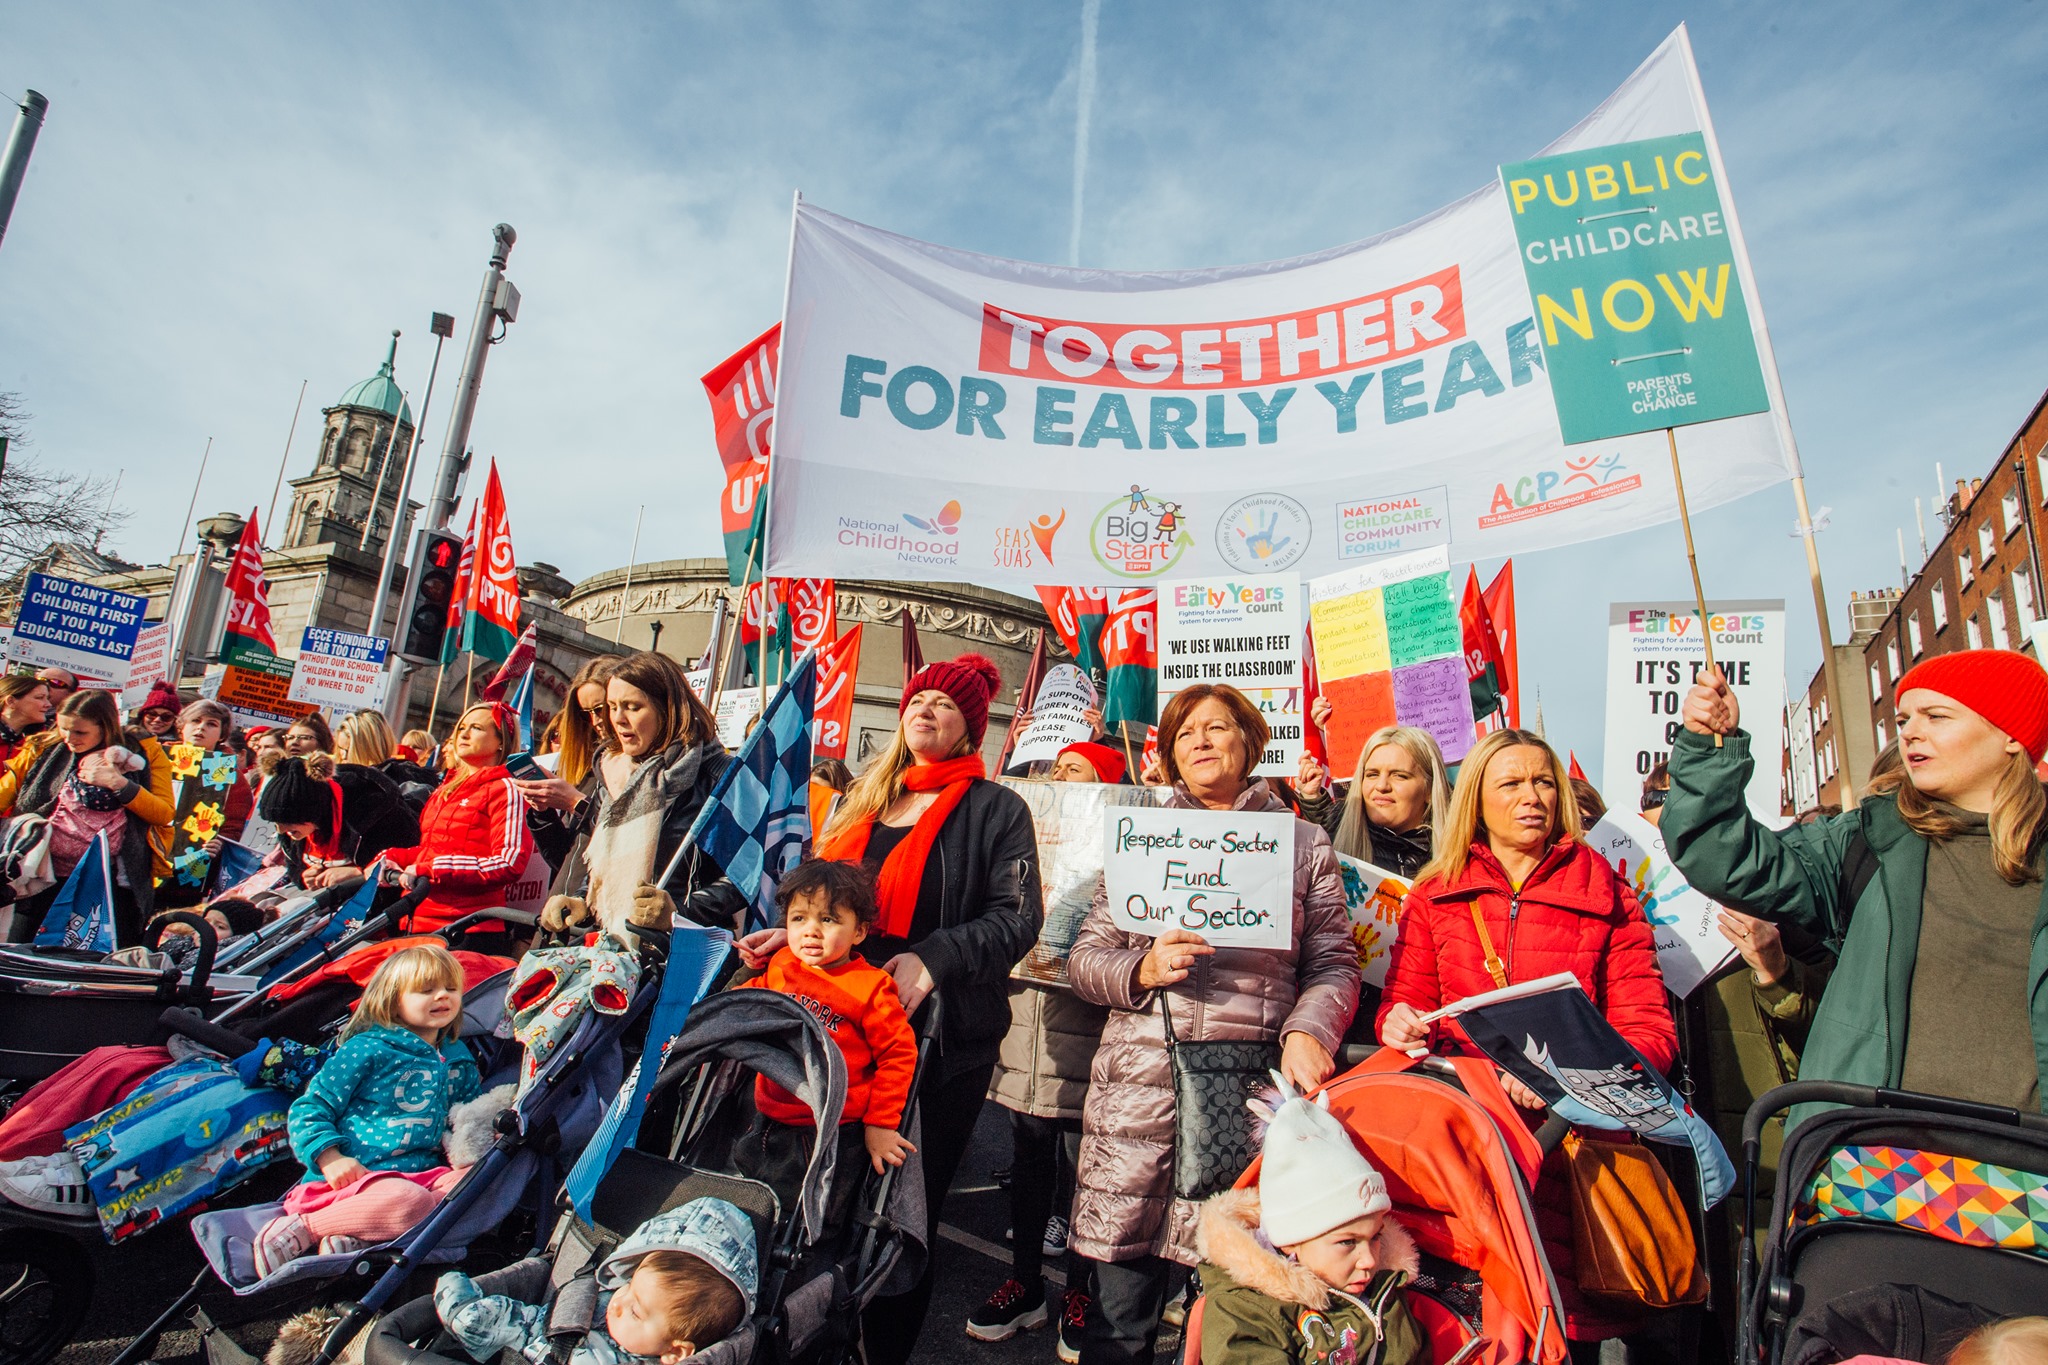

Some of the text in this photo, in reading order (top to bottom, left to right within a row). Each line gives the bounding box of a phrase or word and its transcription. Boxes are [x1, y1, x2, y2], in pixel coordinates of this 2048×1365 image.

[1509, 150, 1708, 215] PUBLIC
[1526, 211, 1723, 264] CHILDCARE
[1537, 263, 1730, 346] NOW
[999, 284, 1449, 385] TOGETHER
[840, 316, 1546, 450] FOR EARLY YEAR
[1626, 372, 1692, 394] PARENTS
[1644, 384, 1679, 402] FOR
[1631, 392, 1697, 414] CHANGE
[1490, 471, 1559, 514] ACP
[1497, 508, 1538, 521] Association
[1539, 503, 1547, 511] of
[1548, 493, 1585, 508] Childhood
[1590, 478, 1636, 496] rofessionals
[1242, 498, 1278, 510] Childhood
[1278, 500, 1302, 523] Providers
[1343, 498, 1421, 518] NATIONAL
[838, 516, 899, 533] National
[1226, 507, 1243, 523] Early
[1343, 507, 1434, 530] CHILDCARE
[994, 527, 1031, 549] SEAS
[1107, 516, 1149, 544] Big
[1344, 518, 1442, 542] COMMUNITY
[837, 529, 959, 556] Childhood
[1105, 538, 1169, 560] Start
[1223, 531, 1241, 563] Federation
[1345, 539, 1401, 555] FORUM
[897, 552, 957, 566] Network
[993, 548, 1032, 568] SUAS
[1272, 547, 1297, 567] IRELAND
[42, 577, 139, 610] YOU CAN'T PUT
[479, 574, 519, 622] IPTU
[1174, 582, 1284, 609] Early Years
[31, 592, 139, 626] CHILDREN FIRST
[1246, 601, 1284, 614] count
[1410, 600, 1448, 615] changing
[1437, 611, 1452, 620] and
[1648, 609, 1666, 618] The
[43, 610, 117, 637] IF YOU PUT
[1212, 616, 1243, 624] everyone
[1628, 609, 1691, 637] Early
[18, 621, 97, 648] EDUCATORS
[98, 638, 132, 656] LAST
[308, 628, 386, 651] ECCE FUNDING IS
[1168, 635, 1291, 655] 'WE USE WALKING FEET
[1633, 636, 1665, 644] Fighting
[1716, 631, 1764, 644] count
[312, 640, 370, 660] FAR TOO LOW
[70, 663, 94, 674] SCHOOL
[95, 669, 114, 678] HOUSE
[269, 663, 294, 672] MONTESS
[300, 653, 380, 674] WITHOUT OUR SCHOOLS,
[302, 664, 375, 684] CHILDREN WILL HAVE
[1164, 660, 1296, 679] INSIDE THE CLASSROOM'
[1635, 660, 1681, 685] IT'S
[306, 676, 365, 694] NO WHERE TO GO
[1048, 691, 1091, 706] SUPPORT
[1648, 690, 1679, 715] TO
[1032, 724, 1066, 733] PLEASE
[1047, 712, 1092, 729] FAMILIES
[1021, 735, 1060, 748] SUPPORT
[1270, 725, 1300, 740] ALKED
[1260, 750, 1284, 764] ORE!
[1115, 816, 1184, 856] Respect
[1189, 837, 1217, 850] our
[1611, 835, 1632, 848] Early
[505, 880, 543, 902] ECTED!
[1126, 894, 1174, 922] Our
